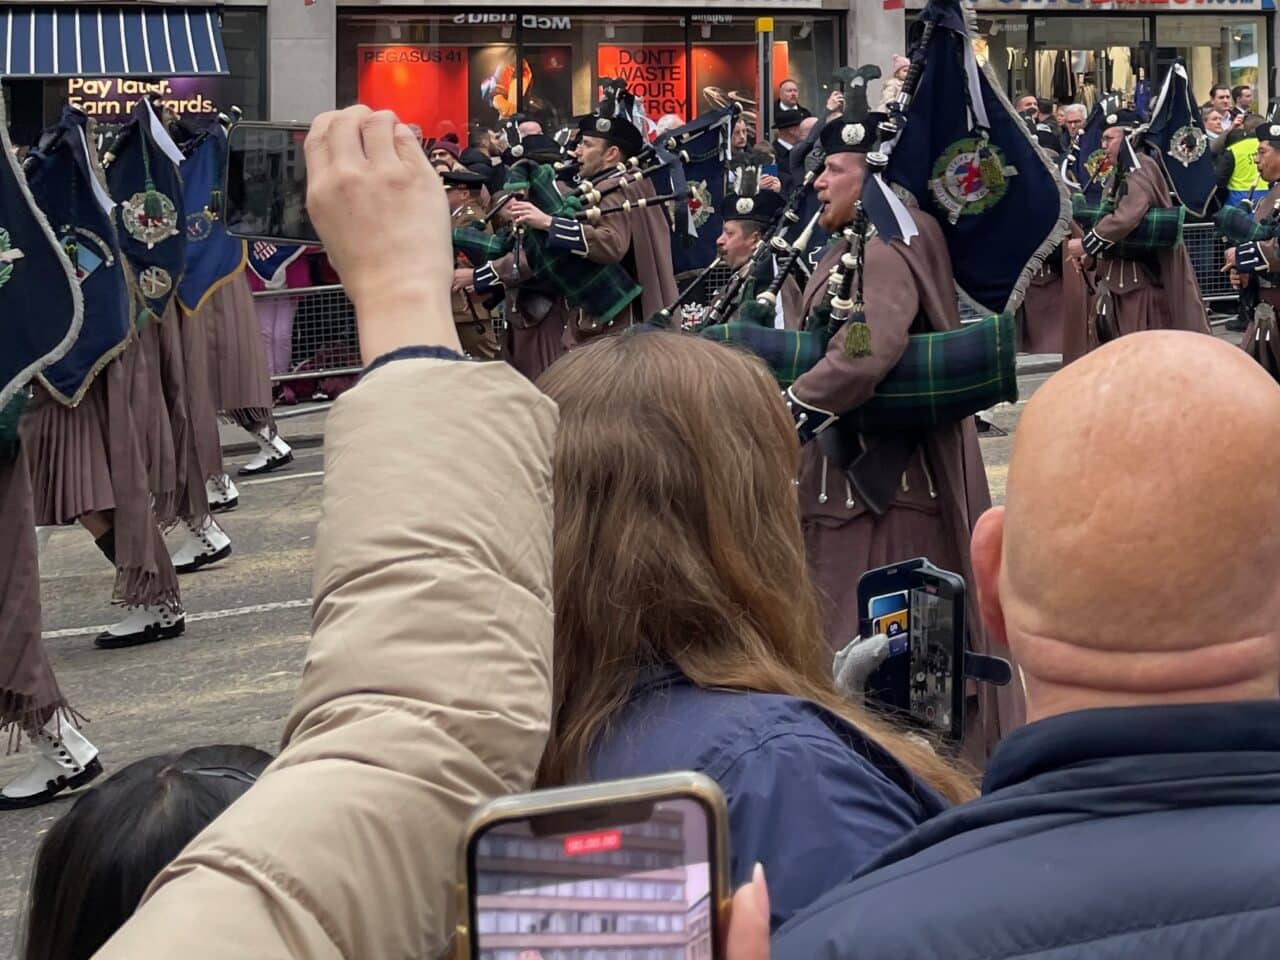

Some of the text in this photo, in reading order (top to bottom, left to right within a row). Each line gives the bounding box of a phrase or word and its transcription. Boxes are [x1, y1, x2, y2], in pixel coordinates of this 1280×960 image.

[363, 50, 462, 64] PEGASUS 41
[619, 49, 677, 65] DON'T
[614, 66, 681, 82] WASTE
[68, 78, 112, 98] Pay
